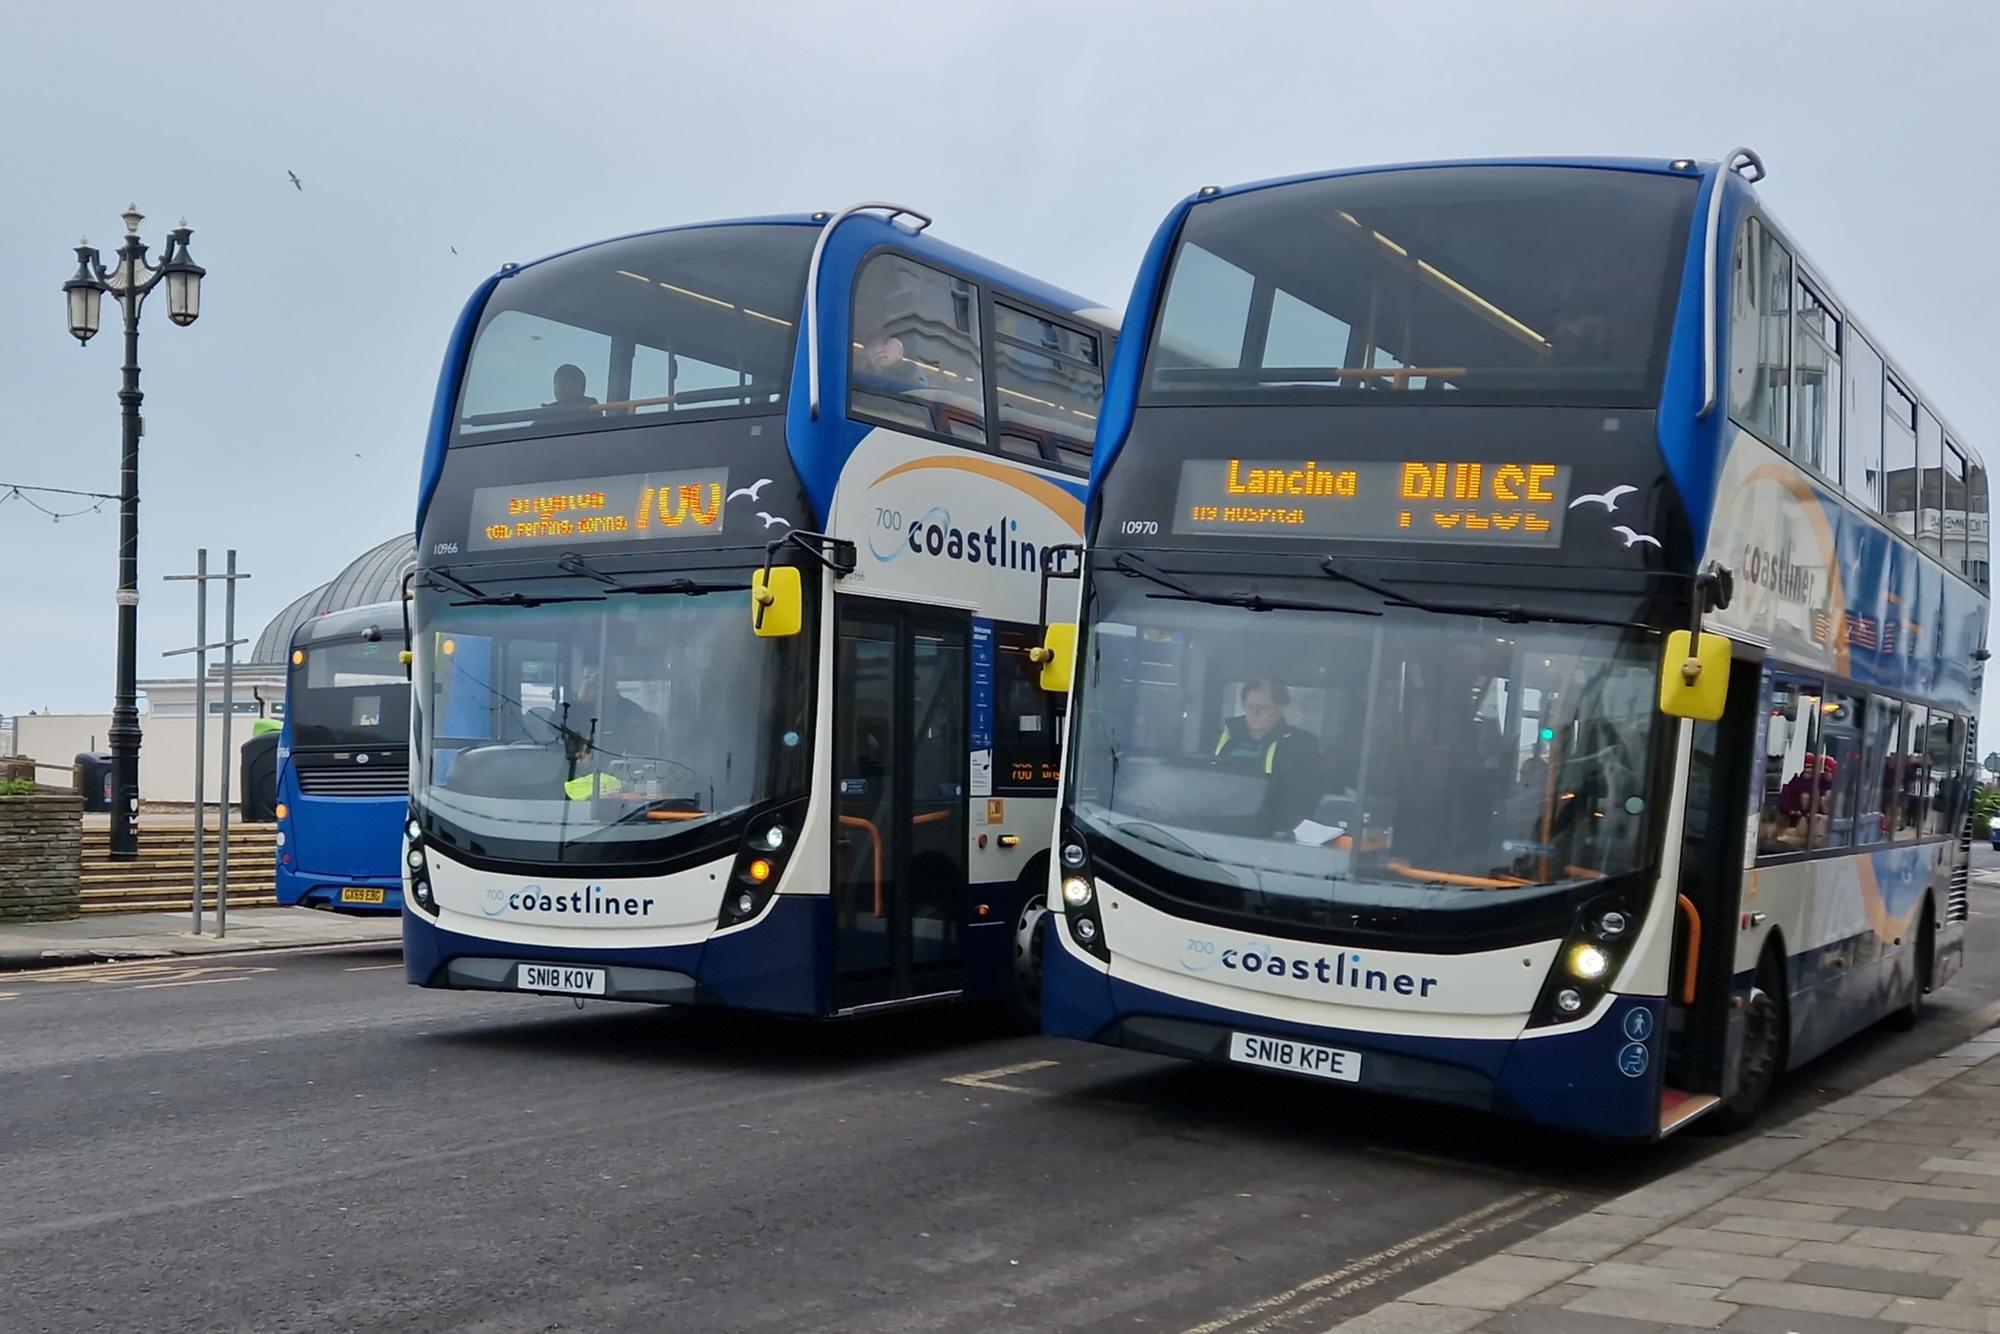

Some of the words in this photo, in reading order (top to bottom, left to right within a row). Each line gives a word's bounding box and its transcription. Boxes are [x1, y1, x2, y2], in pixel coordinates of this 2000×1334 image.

[875, 507, 901, 531] 700
[1121, 521, 1159, 535] 10970
[433, 543, 458, 555] 10966
[487, 889, 504, 901] 700
[509, 885, 654, 916] coastliner
[527, 967, 560, 986] SN18
[564, 970, 594, 989] KOV
[1187, 939, 1215, 955] 700
[1222, 950, 1438, 998] coastliner
[1245, 1038, 1293, 1064] SN18
[1300, 1047, 1345, 1073] KPE
